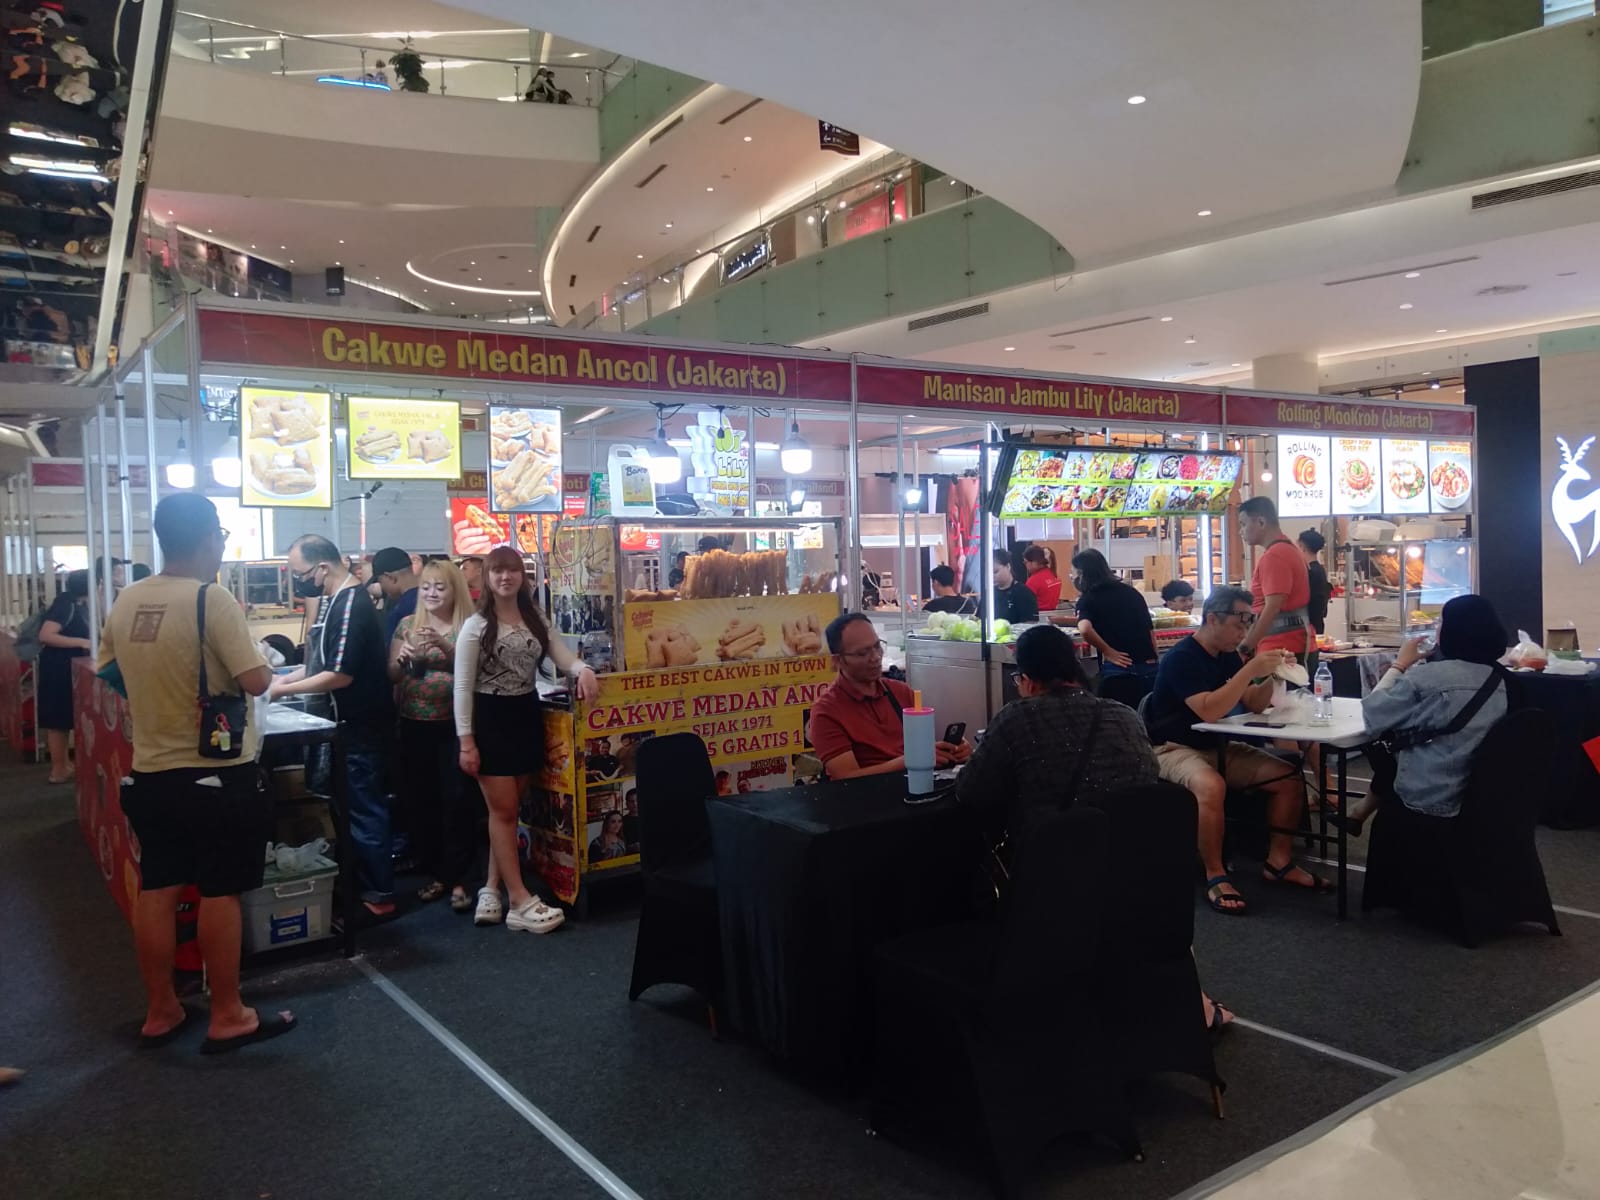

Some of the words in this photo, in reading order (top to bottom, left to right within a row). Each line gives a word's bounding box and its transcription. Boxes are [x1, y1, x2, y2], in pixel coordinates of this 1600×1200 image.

[322, 327, 447, 369] Cakwe
[456, 338, 568, 378] Medan
[576, 348, 658, 383] Ancol
[666, 354, 787, 395] (Jakarta)
[923, 375, 1005, 404] Manisan
[1010, 382, 1070, 409] Jambu
[1075, 386, 1104, 416] Lily
[1108, 388, 1180, 419] (Jakarta)
[1277, 401, 1321, 428] Rolling
[1324, 404, 1378, 426] MooKrob
[1382, 409, 1433, 431] (Jakarta)
[1287, 440, 1323, 457] ROLLING
[620, 674, 656, 691] THE
[660, 670, 700, 687] BEST
[703, 664, 761, 682] CAKWE
[764, 663, 780, 676] IN
[784, 657, 827, 674] TOWN
[587, 699, 686, 731] CAKWE
[692, 687, 778, 718] MEDAN
[692, 718, 738, 738] SEJAK
[741, 715, 773, 731] 1971
[722, 731, 788, 756] GRATIS
[794, 730, 802, 745] 1
